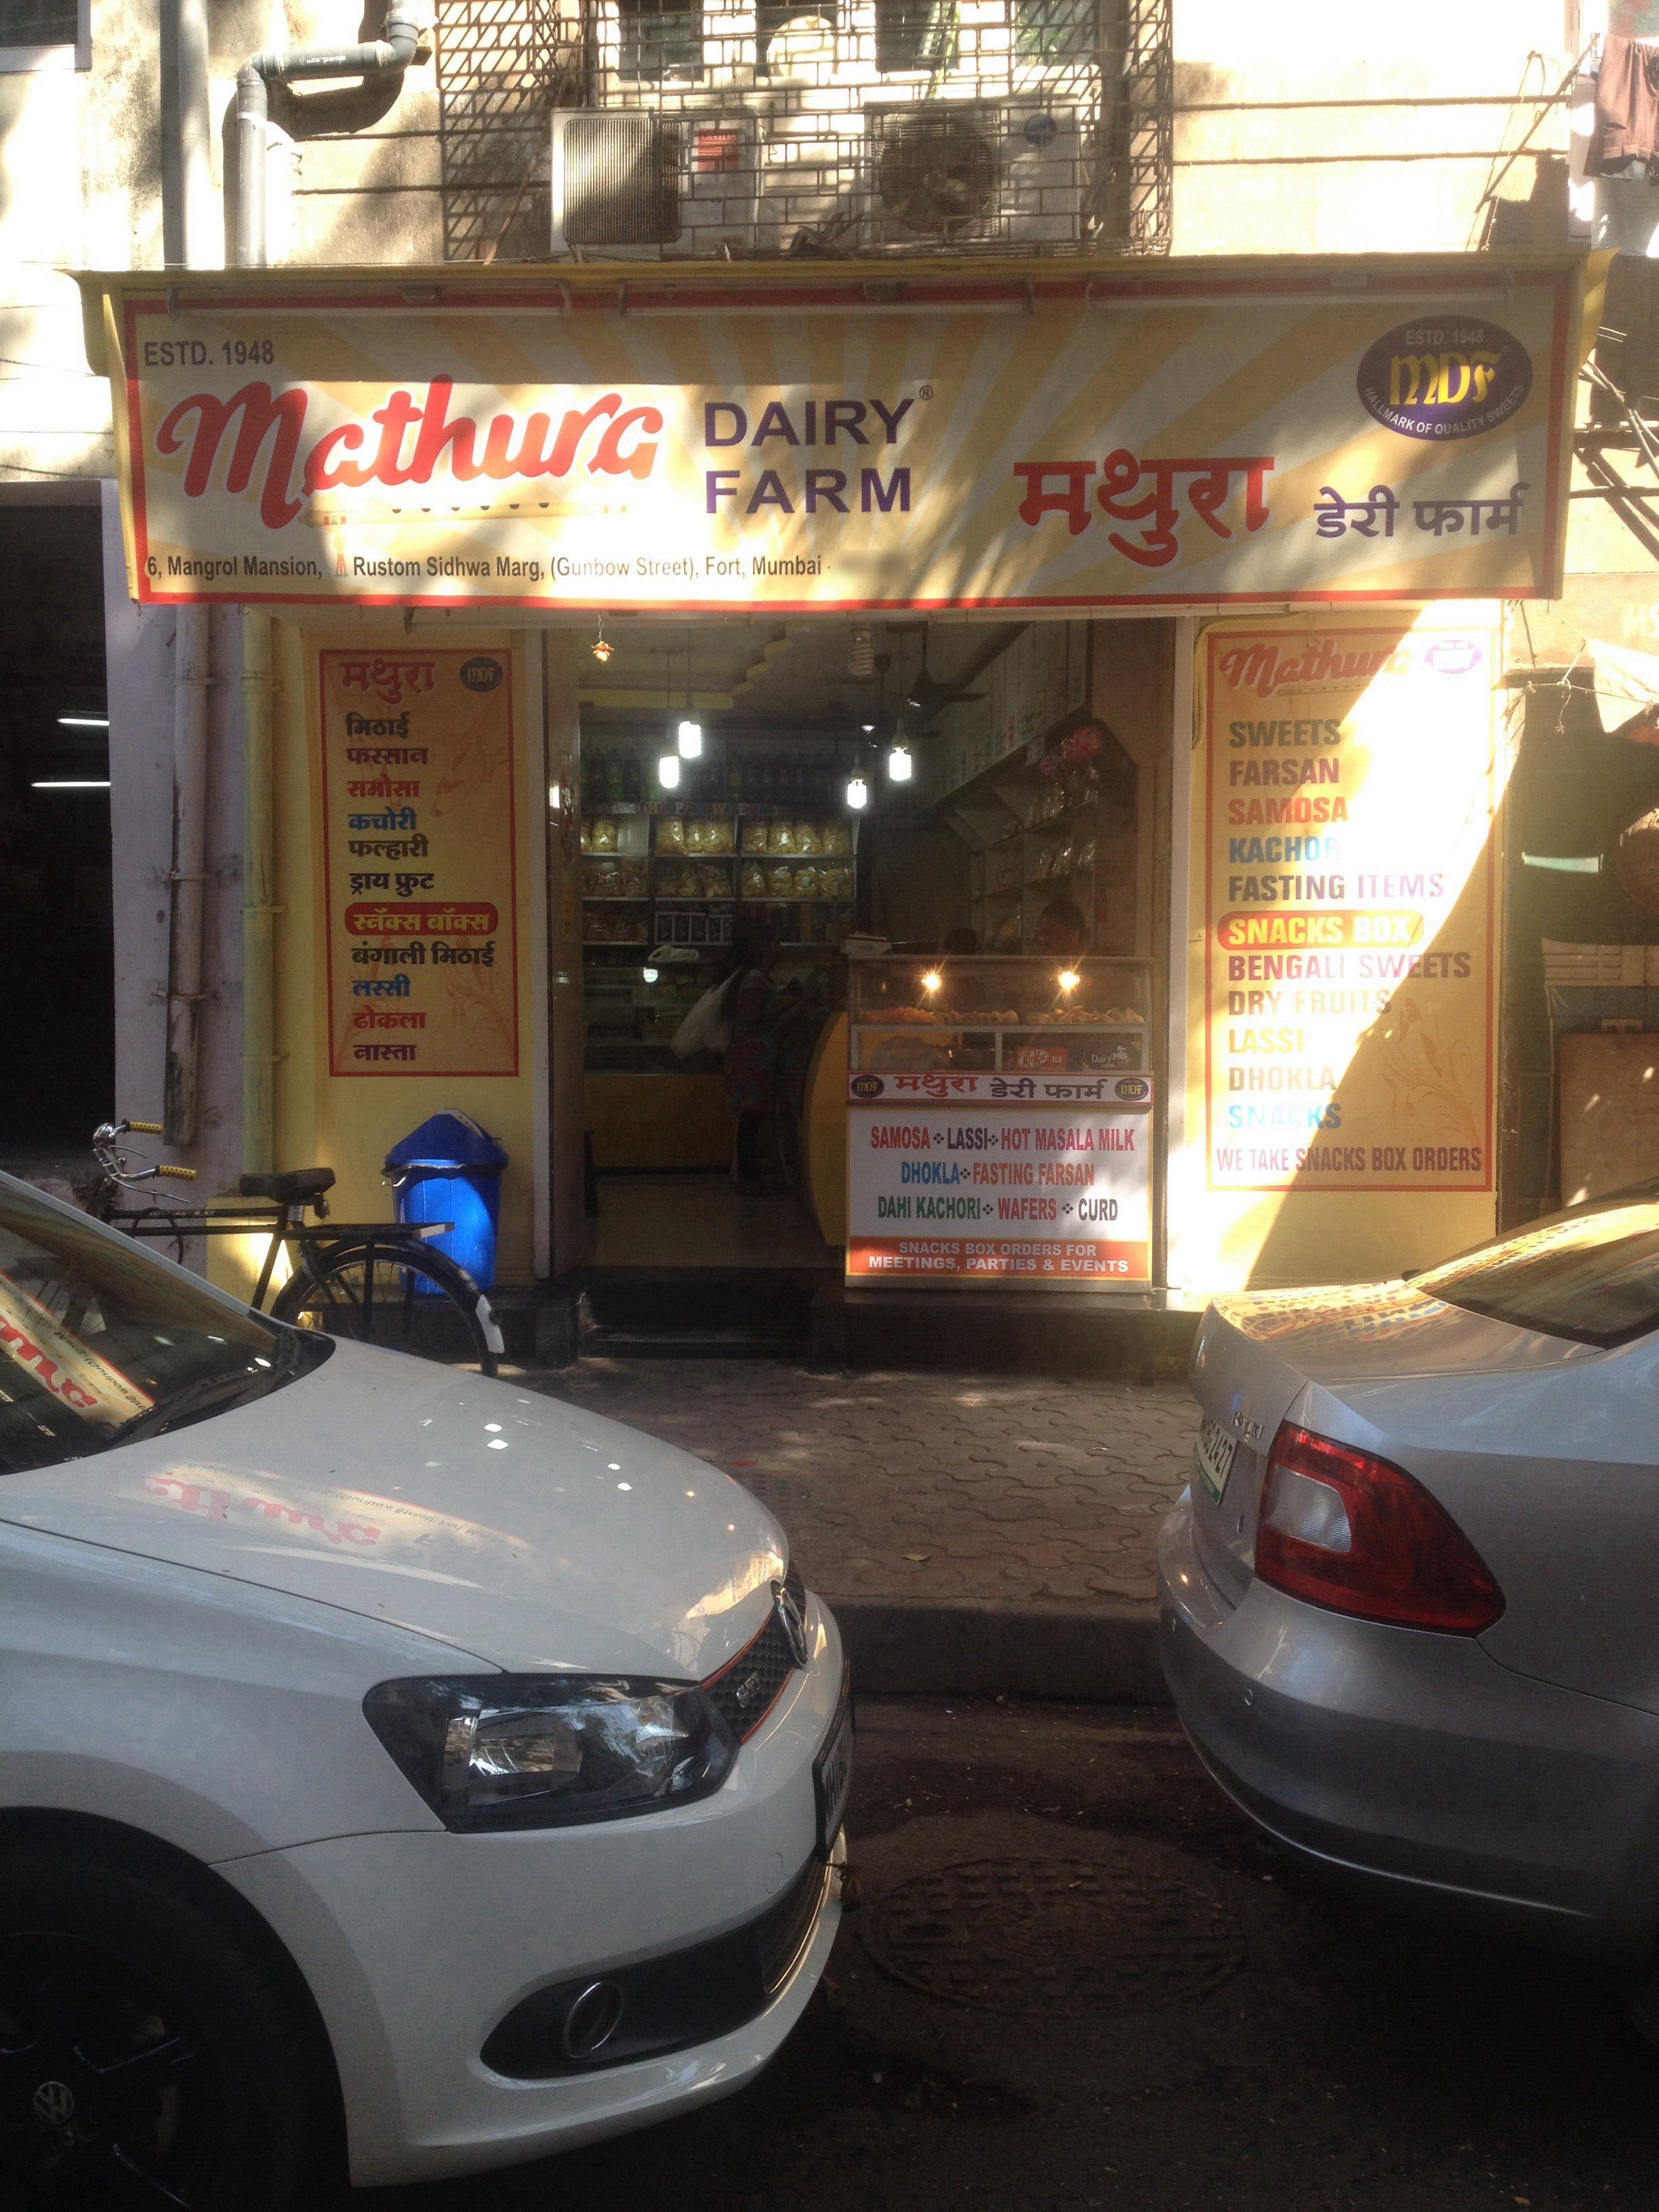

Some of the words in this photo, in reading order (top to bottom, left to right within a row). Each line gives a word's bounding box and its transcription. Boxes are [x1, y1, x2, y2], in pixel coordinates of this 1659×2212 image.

[1406, 329, 1448, 346] ESTD.
[1452, 328, 1484, 345] 1948
[144, 341, 214, 367] ESTD.
[222, 339, 274, 365] 1948
[704, 398, 915, 447] DAIRY
[1365, 386, 1414, 432] HALLMARK
[1416, 421, 1433, 434] OF
[1435, 415, 1484, 434] QUALITY
[1485, 384, 1524, 423] SWEETS
[157, 373, 663, 529] Mathura
[705, 467, 911, 514] FARM
[1014, 448, 1275, 569] मथुरा
[1313, 485, 1400, 538] डेरी
[1412, 482, 1530, 537] फार्म
[147, 557, 163, 579] 6,
[167, 555, 239, 582] Mangrol
[243, 555, 323, 579] Mansion,
[352, 556, 420, 577] Rustom
[426, 554, 491, 578] Sidhwa
[495, 555, 546, 584] Marg,
[550, 555, 630, 581] (Gunbow
[636, 556, 700, 581] Street),
[705, 556, 745, 579] Fort,
[752, 555, 822, 576] Mumbai
[340, 657, 436, 705] मथुरा
[1219, 639, 1412, 699] Mathura
[346, 712, 411, 739] मिठाई
[1229, 718, 1342, 748] SWEETS
[346, 747, 429, 765] फरसान
[346, 773, 421, 798] समोसा
[1229, 758, 1340, 787] FARSAN
[348, 805, 417, 831] कचोरी
[1228, 796, 1349, 826] SAMOSA
[348, 833, 429, 861] फल्हारी
[349, 872, 390, 895] ड्राय
[1229, 874, 1345, 903] FASTING
[1357, 873, 1445, 899] ITEMS
[426, 907, 489, 932] बॉक्स
[1228, 916, 1344, 946] SNACKS
[1354, 916, 1412, 943] BOX
[351, 941, 426, 966] बंगाली
[431, 940, 496, 968] मिठाई
[1228, 954, 1346, 981] BENGALI
[1358, 951, 1472, 979] SWEETS
[351, 972, 411, 998] लस्सी
[1228, 989, 1283, 1016] DRY
[1294, 988, 1392, 1015] FRUITS
[352, 1004, 427, 1030] ढोकला
[353, 1044, 417, 1062] नास्ता
[1228, 1028, 1304, 1054] LASSI
[894, 1074, 979, 1098] मथुरा
[989, 1077, 1038, 1099] डेरी
[1043, 1078, 1108, 1100] फार्म
[1228, 1065, 1338, 1092] DHOKLA
[1228, 1103, 1342, 1130] SNACKS
[870, 1126, 930, 1150] SAMOSA
[947, 1126, 989, 1151] LASSI
[1001, 1128, 1031, 1151] HOT
[1035, 1128, 1094, 1151] MASALA
[1099, 1128, 1136, 1152] MILK
[1216, 1148, 1244, 1172] WE
[1251, 1147, 1290, 1172] TAKE
[1295, 1147, 1367, 1172] SNACKS
[1372, 1147, 1408, 1172] BOX
[1412, 1146, 1483, 1172] ORDERS
[901, 1161, 960, 1185] DHOKLA
[972, 1162, 1034, 1187] FASTING
[1038, 1162, 1095, 1187] FARSAN
[878, 1195, 912, 1219] DAHI
[916, 1195, 981, 1219] KACHORI
[998, 1197, 1057, 1221] WAFERS
[1078, 1197, 1118, 1221] CURD
[899, 1241, 960, 1255] SNACKS
[964, 1242, 996, 1256] BOX
[1000, 1242, 1063, 1256] ORDERS
[1066, 1244, 1097, 1257] FOR
[868, 1255, 962, 1271] MEETINGS,
[966, 1257, 1038, 1271] PARTIES
[1042, 1258, 1055, 1271] &
[1061, 1258, 1128, 1273] EVENTS
